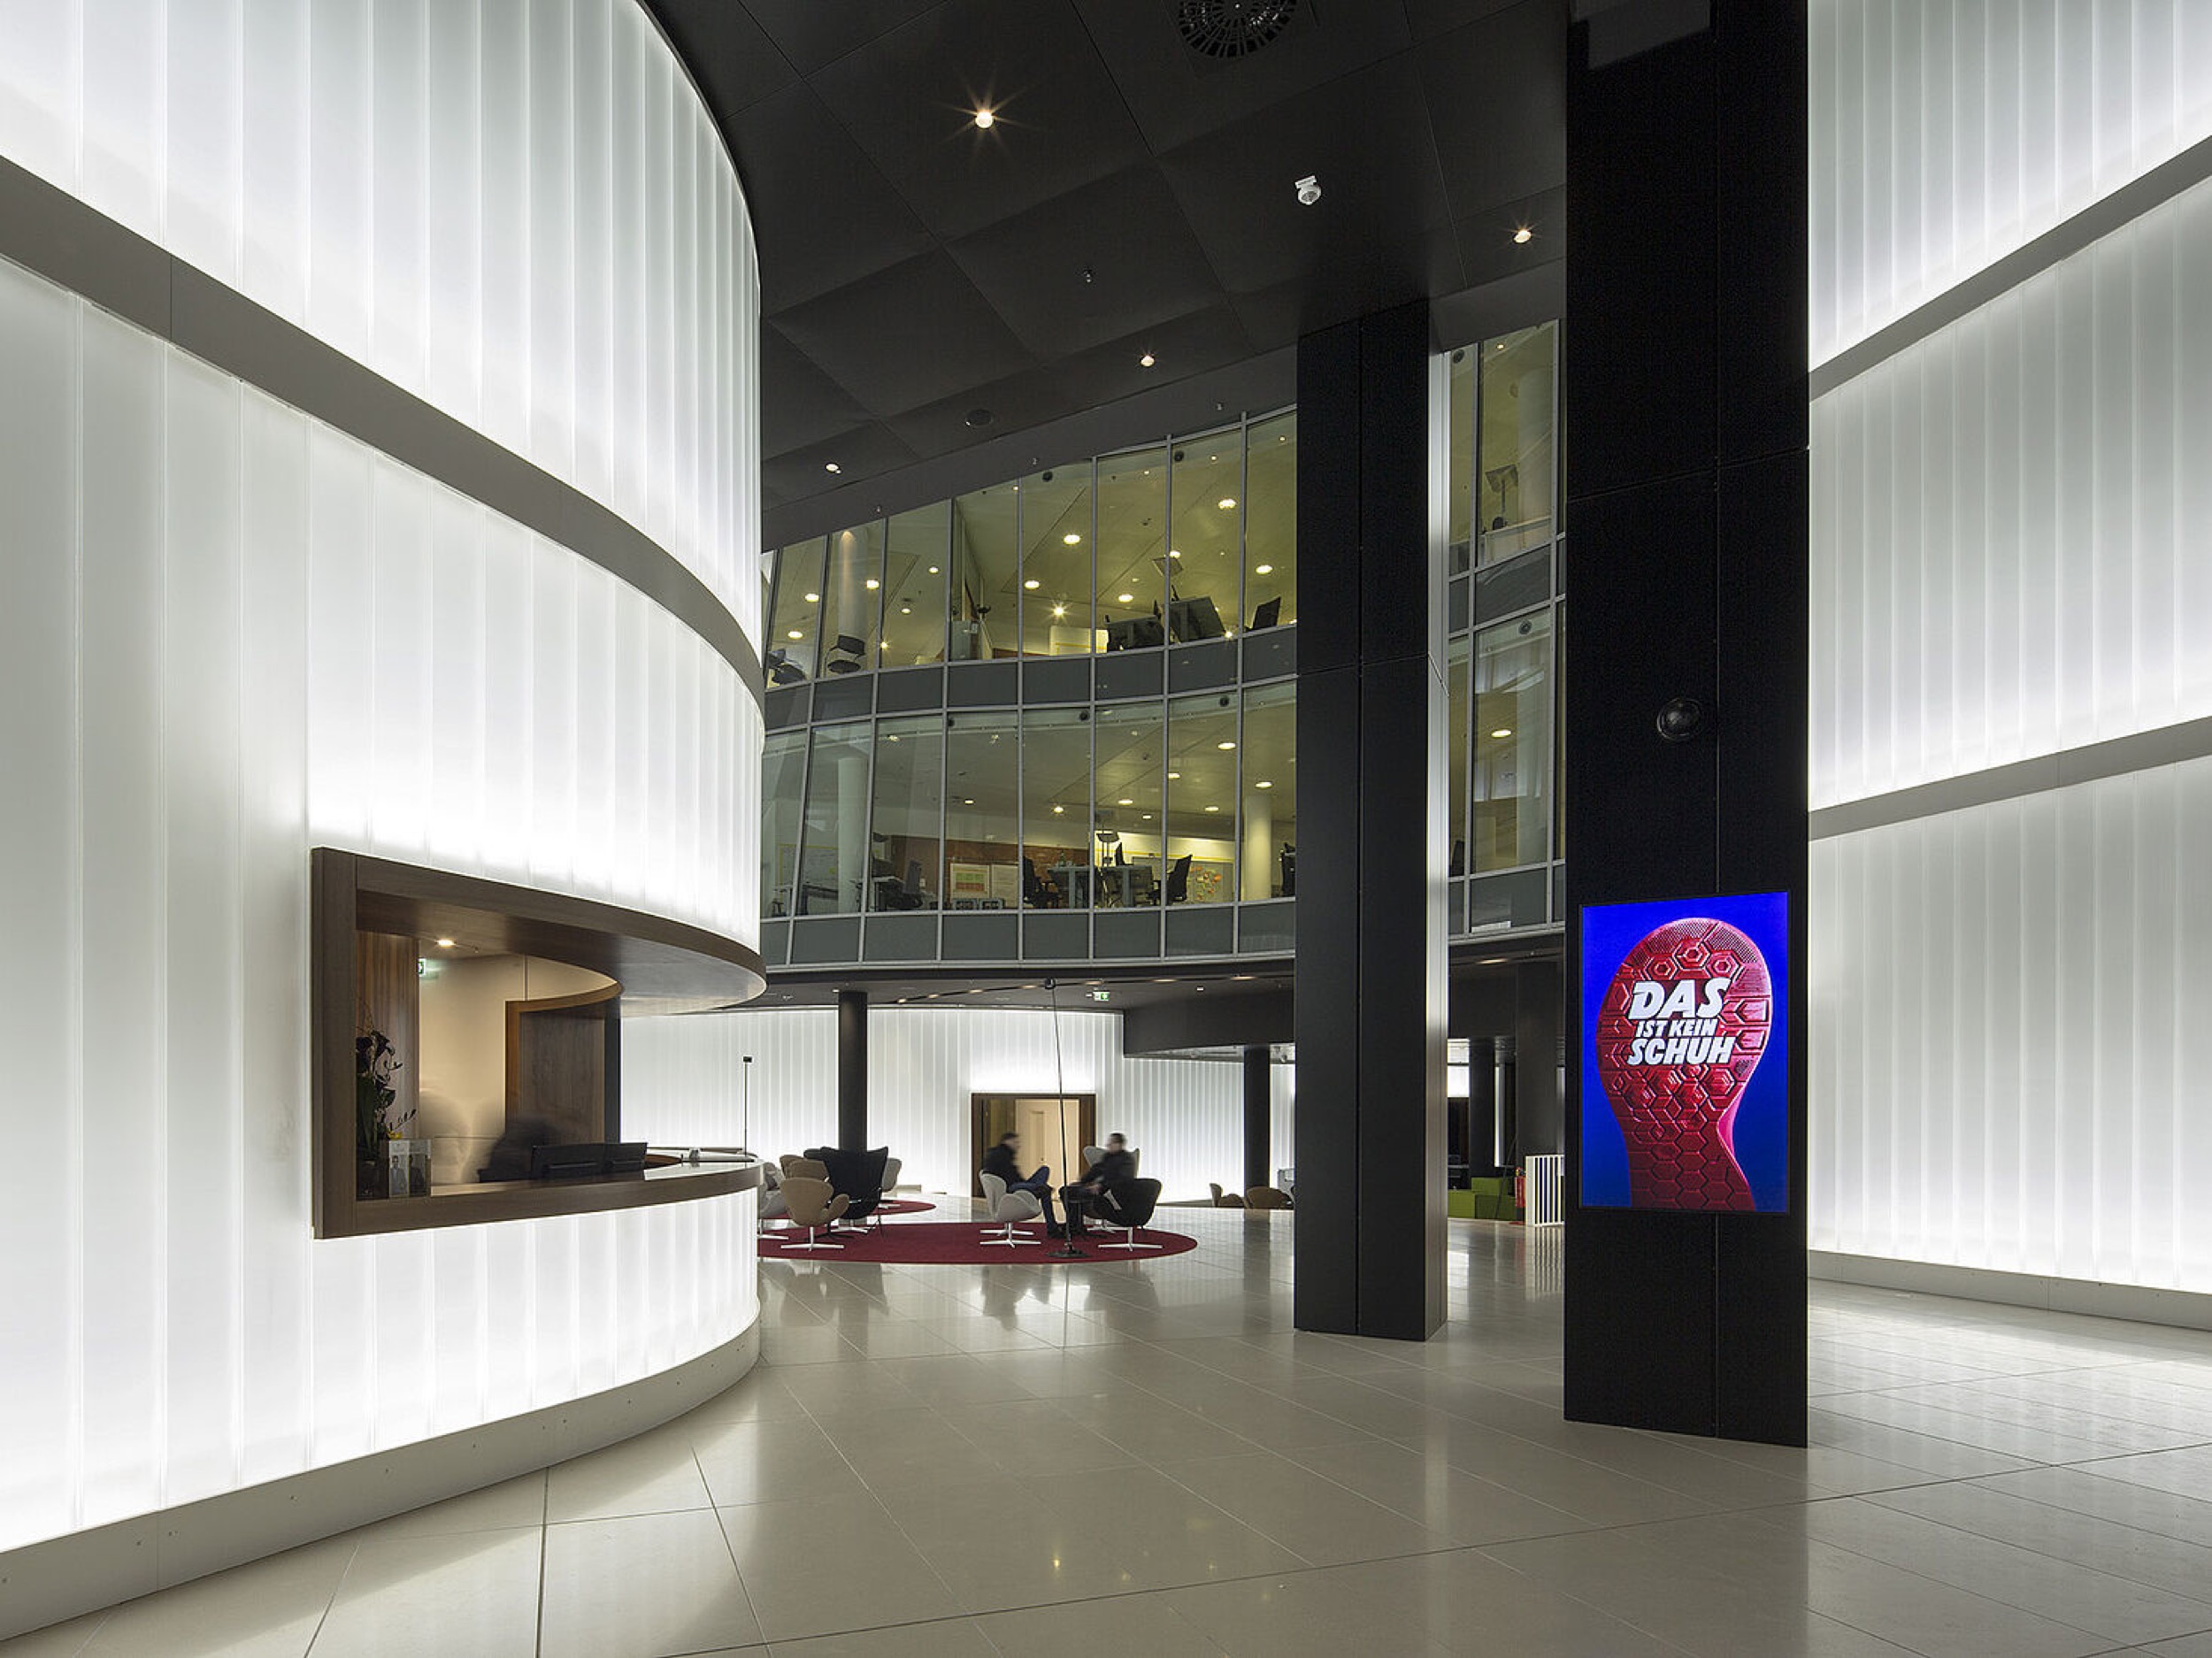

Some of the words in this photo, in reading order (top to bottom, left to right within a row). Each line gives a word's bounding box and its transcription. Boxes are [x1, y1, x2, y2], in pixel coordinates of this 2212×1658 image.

[1628, 978, 1731, 1019] DAS
[1635, 1019, 1668, 1038] IST
[1669, 1018, 1718, 1037] KEIN
[1627, 1036, 1736, 1065] SCHUH
